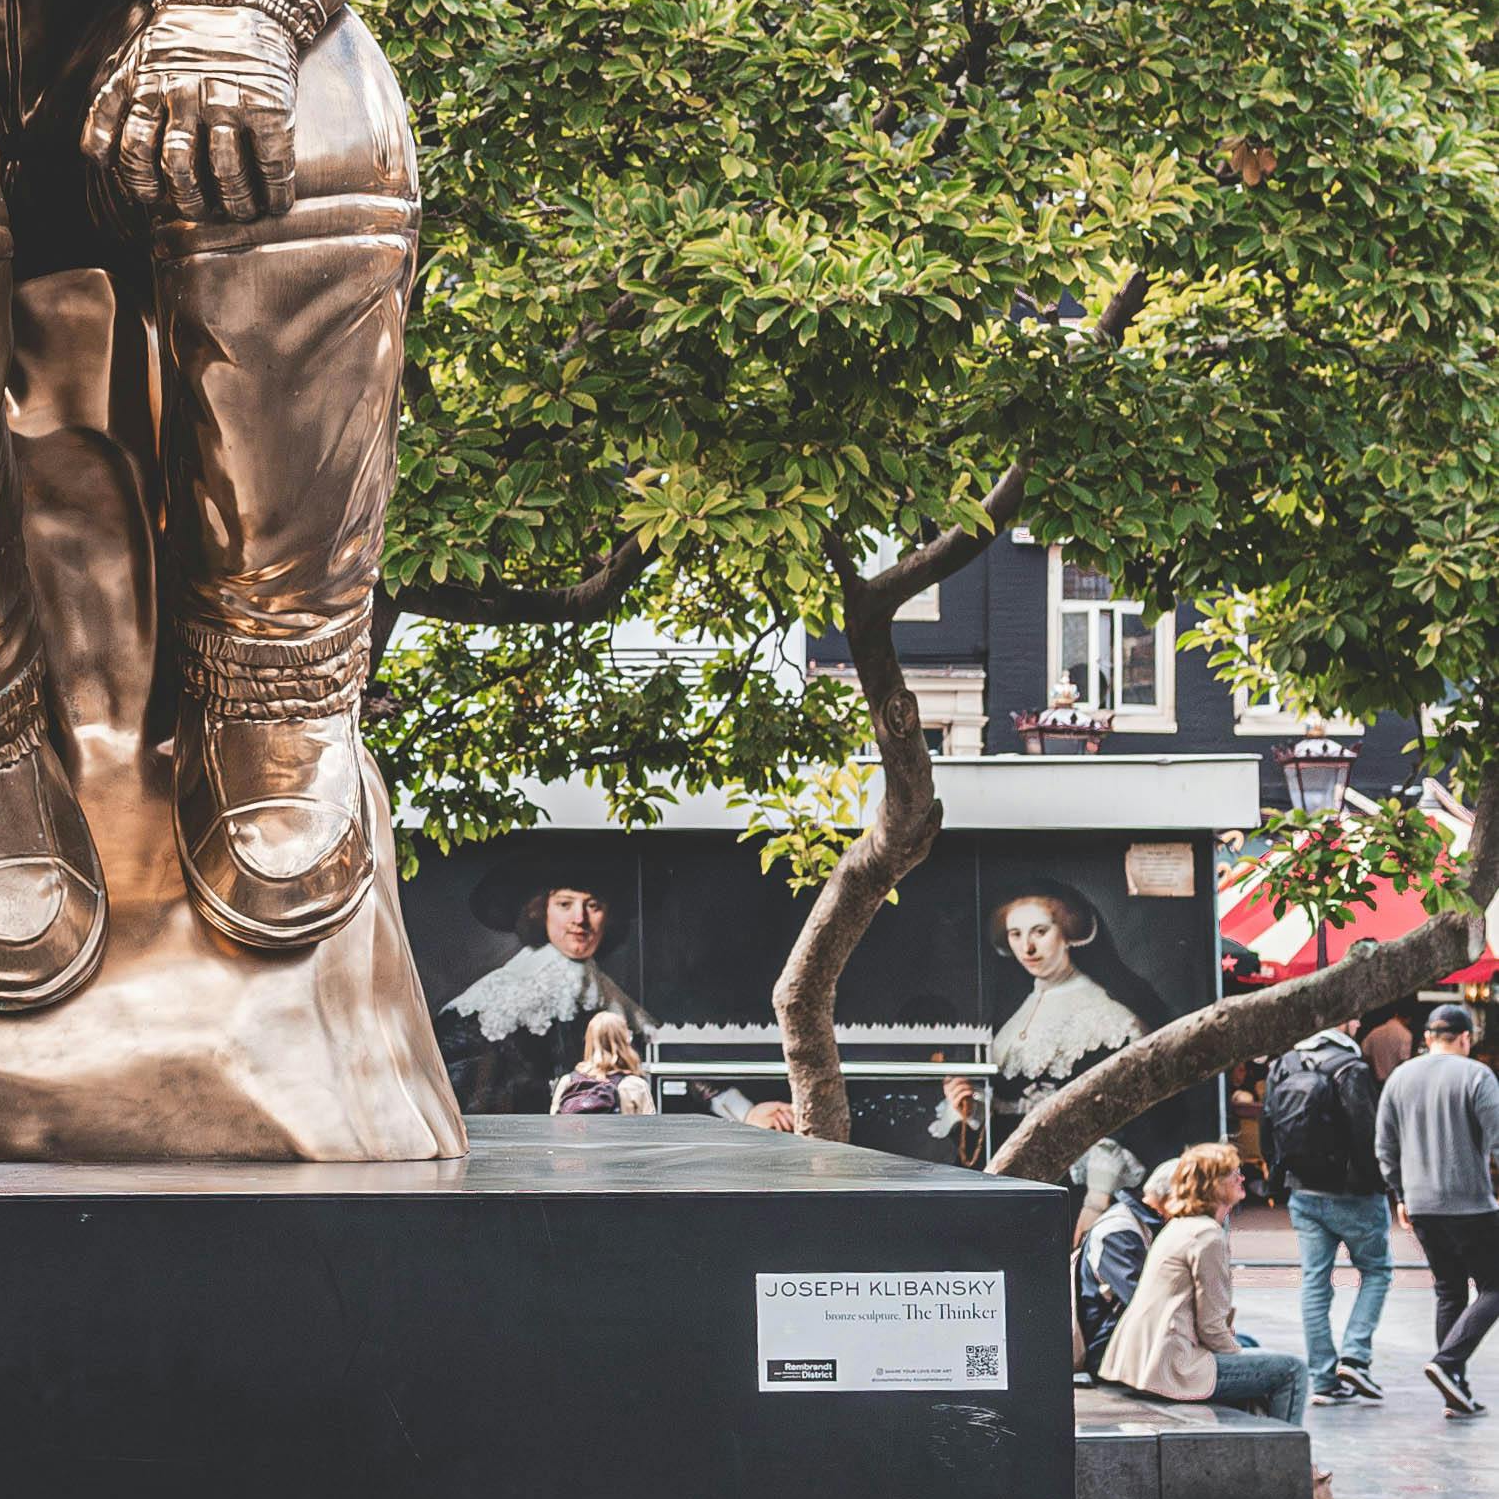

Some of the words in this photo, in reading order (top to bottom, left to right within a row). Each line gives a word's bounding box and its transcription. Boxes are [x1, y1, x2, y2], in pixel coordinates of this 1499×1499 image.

[764, 1281, 860, 1297] JOSEPH
[869, 1280, 996, 1296] KLIBANSKY
[825, 1309, 856, 1321] bronze
[902, 1303, 932, 1320] The
[935, 1302, 998, 1320] Thinker
[784, 1362, 833, 1371] Rembrandt
[801, 1371, 833, 1379] District
